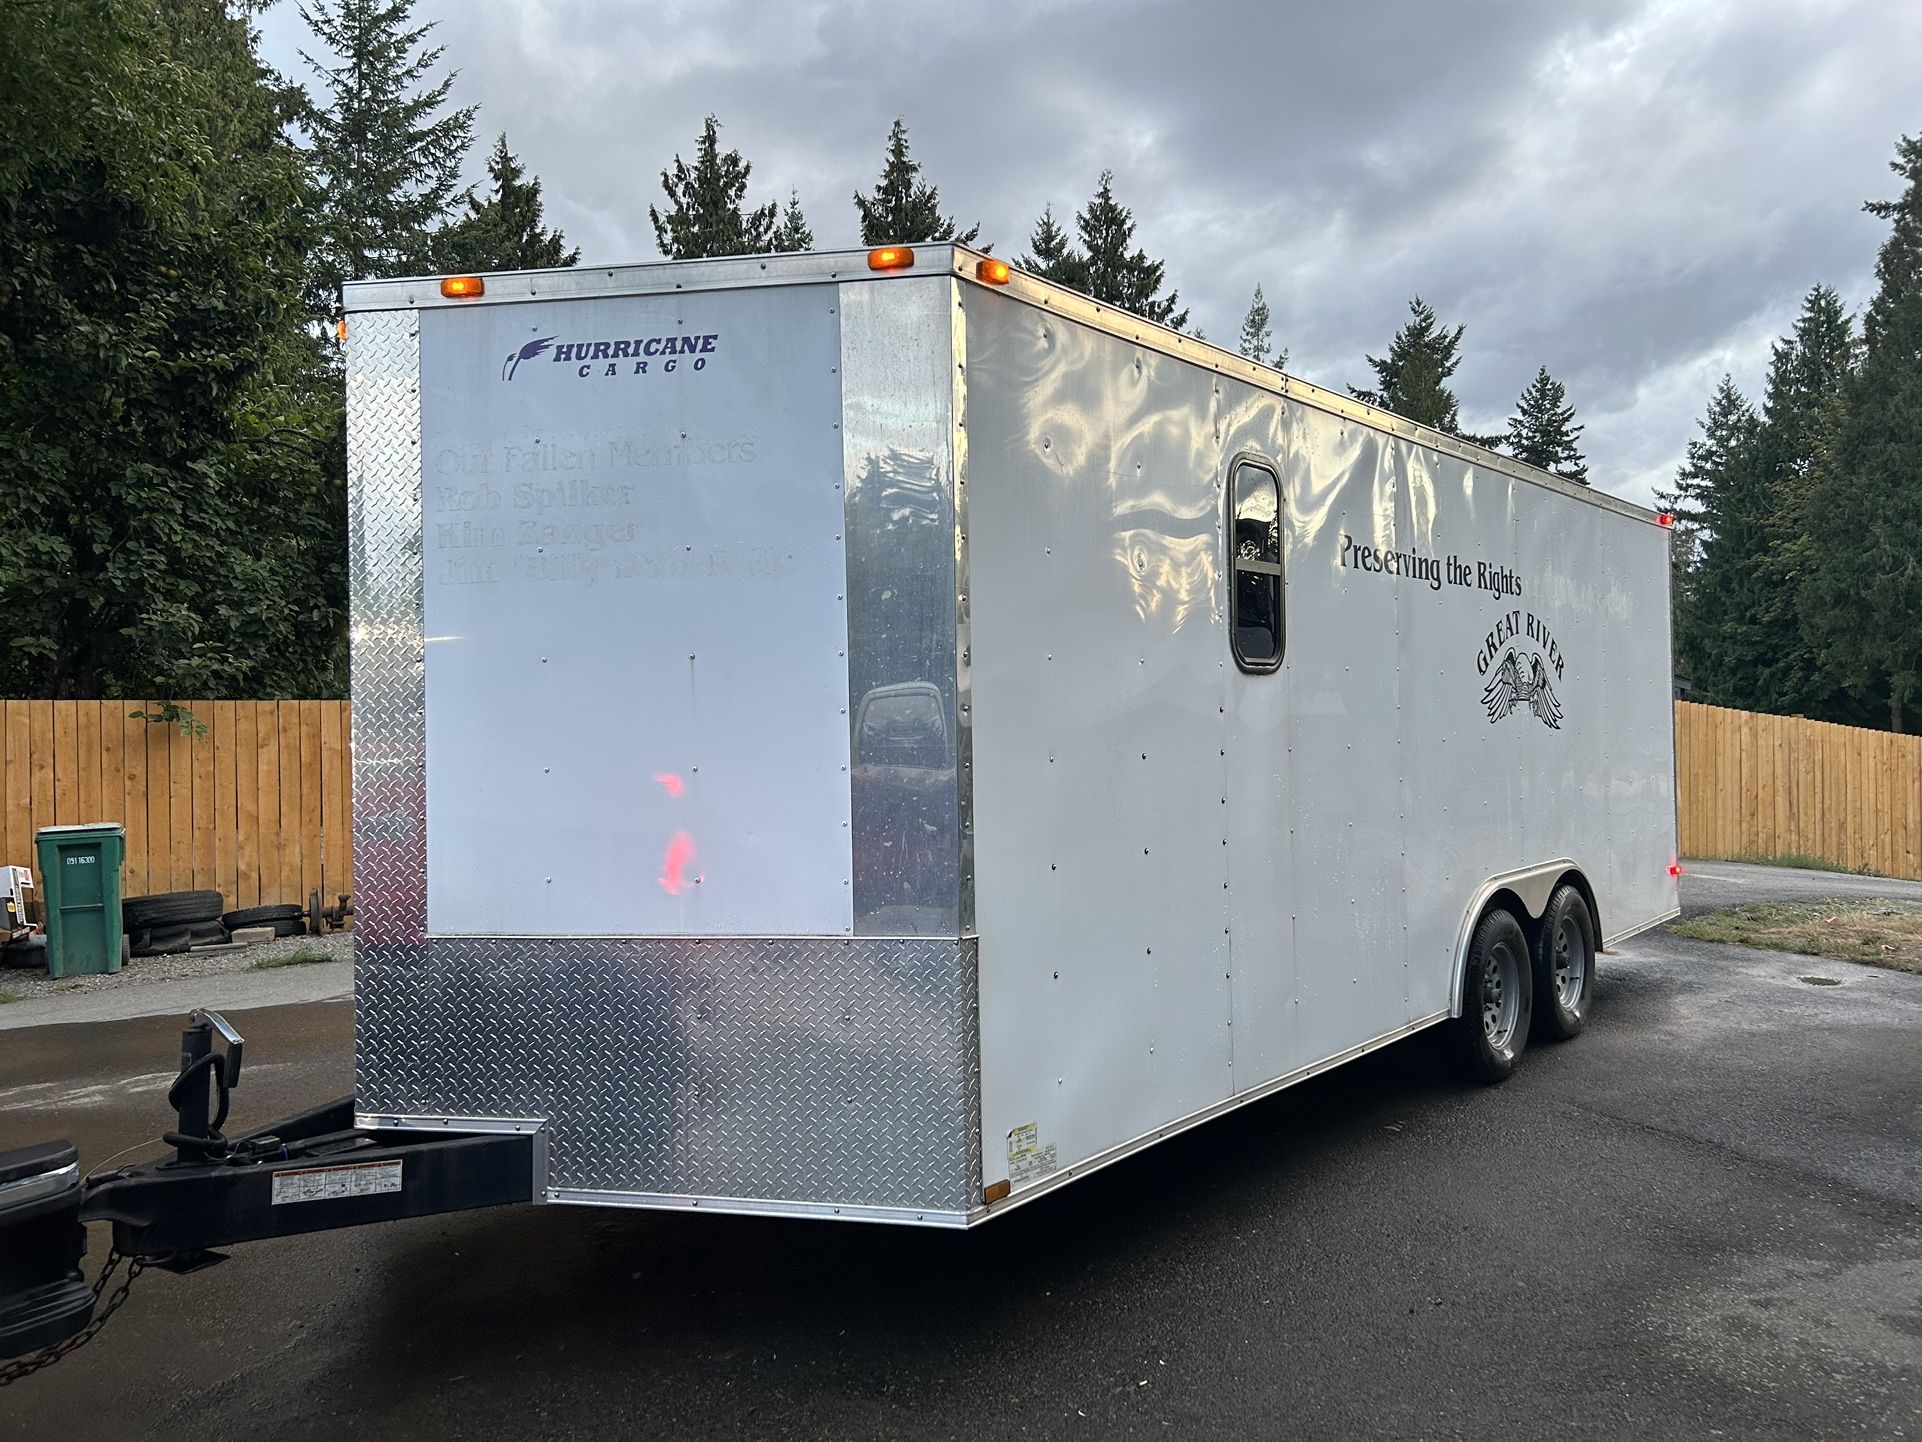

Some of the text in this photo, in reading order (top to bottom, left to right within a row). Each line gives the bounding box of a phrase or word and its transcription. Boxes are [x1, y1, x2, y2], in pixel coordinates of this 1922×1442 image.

[553, 334, 719, 362] HURRICANE
[578, 358, 707, 378] CARGO
[504, 444, 595, 473] Fallen
[1339, 534, 1523, 600] Preserving the Rights
[1476, 610, 1565, 683] GREAT RIVER
